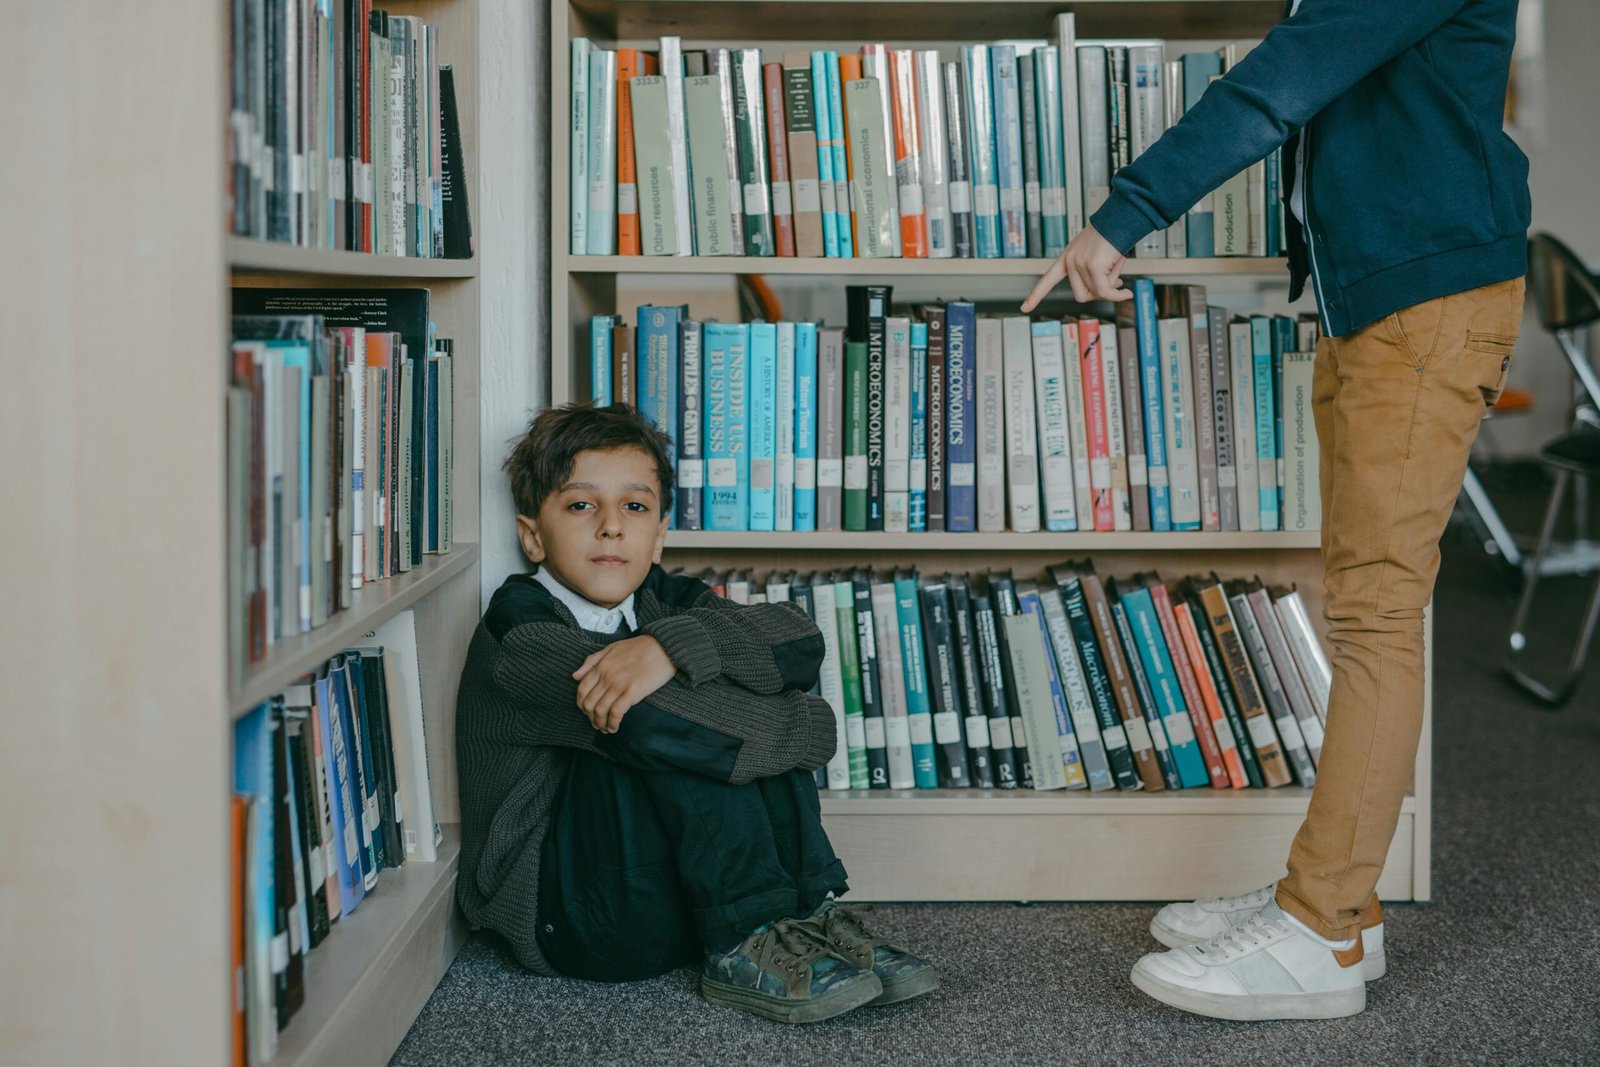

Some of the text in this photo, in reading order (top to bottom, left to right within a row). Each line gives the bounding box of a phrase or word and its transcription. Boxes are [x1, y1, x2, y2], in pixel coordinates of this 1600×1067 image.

[635, 76, 660, 87] 333.9
[693, 76, 710, 87] 336
[853, 80, 870, 90] 337
[859, 128, 873, 187] economics
[650, 165, 665, 254] Other resources
[705, 176, 719, 254] Public finance
[1224, 193, 1235, 253] Production
[684, 329, 699, 456] PROFILES GENIUS
[709, 349, 725, 452] BUSINESS
[728, 344, 744, 457] INSIDE U.S.
[763, 364, 772, 398] HISTORY
[763, 401, 772, 411] OF
[868, 332, 882, 467] MICROECONOMICS
[949, 324, 964, 445] MICROECONOMICS
[1043, 377, 1062, 432] MANAGERIAL
[1107, 360, 1120, 439] ENTREPRENEURS
[1197, 344, 1212, 450] MICROECONOMICS
[1256, 361, 1268, 376] The
[763, 414, 772, 457] AMERICAN
[799, 375, 811, 448] Nature Tourism
[931, 364, 942, 491] MICROECONOMICS
[1216, 388, 1229, 467] ECONOMICS
[712, 491, 737, 501] 1994
[1294, 385, 1306, 529] Organization of production
[1017, 649, 1029, 686] related
[1051, 616, 1089, 711] MACROECONOMICS
[1080, 640, 1114, 727] Macroeconom
